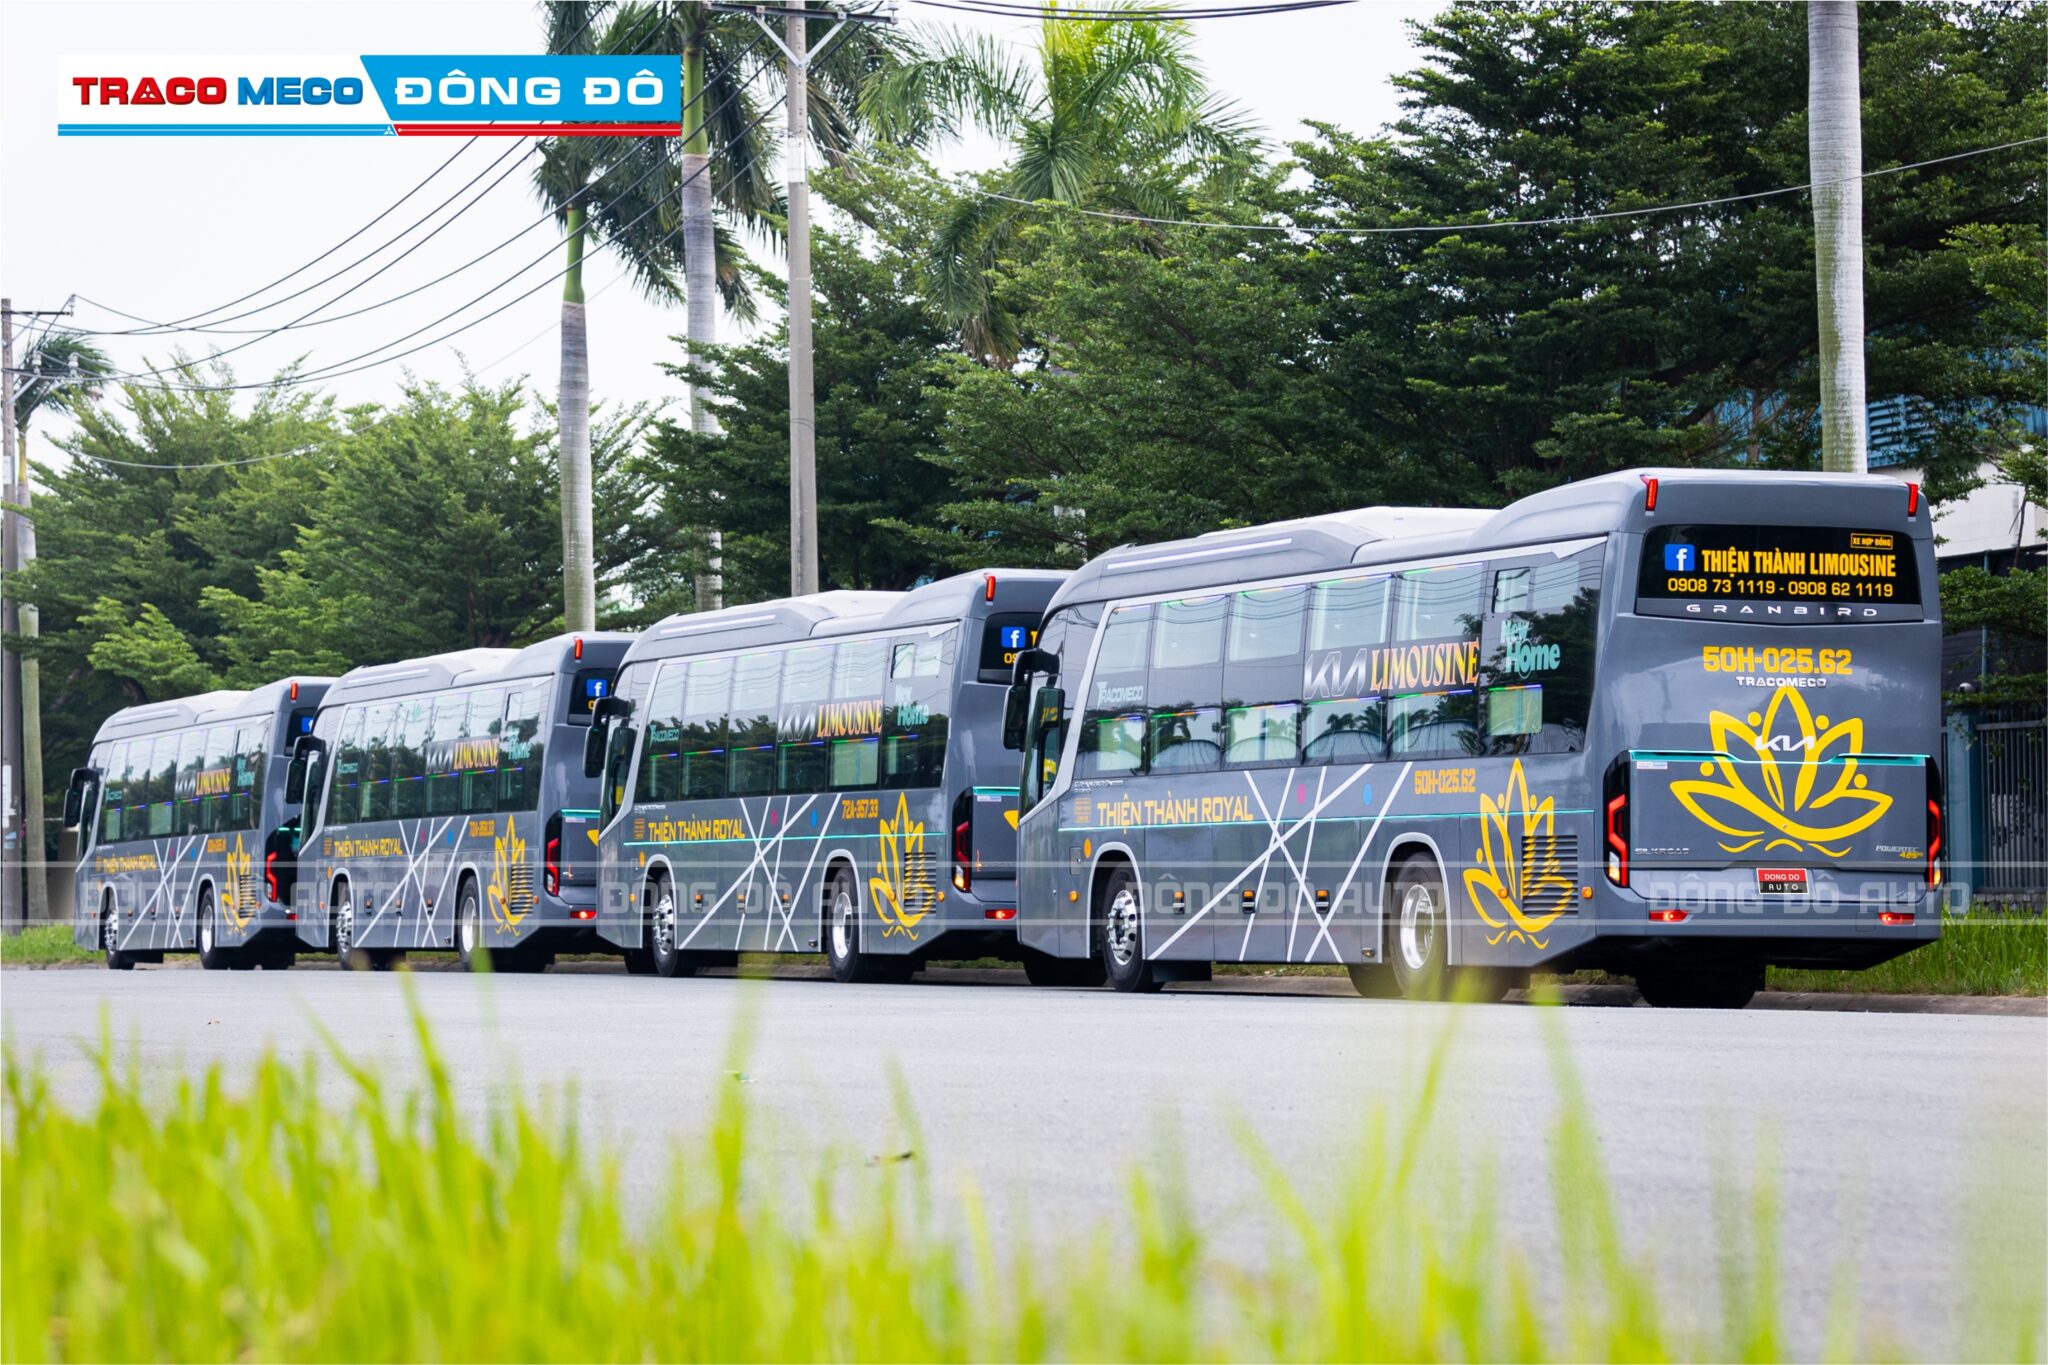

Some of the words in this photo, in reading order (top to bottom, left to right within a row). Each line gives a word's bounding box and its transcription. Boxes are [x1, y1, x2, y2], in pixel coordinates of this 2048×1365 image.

[1702, 546, 1749, 577] THIỆN
[1753, 547, 1805, 575] THÀNH
[1810, 553, 1896, 577] LIMOUSINE
[1668, 578, 1707, 593] 0908
[1712, 579, 1732, 593] 73
[1737, 580, 1775, 594] 1119
[1788, 581, 1827, 596] 0908
[1831, 582, 1850, 596] 62
[1856, 583, 1893, 597] 1119
[1686, 603, 1877, 617] GRANBIRD
[1370, 637, 1480, 691] LIMOUSINE
[1505, 640, 1560, 676] Home
[1702, 645, 1853, 675] 50H-025.62
[1736, 676, 1827, 688] TRACOMECO
[817, 697, 882, 738] LIMOUSINE
[1414, 768, 1476, 794] 50H-025.62
[1201, 795, 1254, 822] ROYAL
[714, 818, 745, 840] ROYAL
[1764, 873, 1787, 881] DONG
[1788, 873, 1800, 881] DO
[1768, 883, 1798, 891] AUTO
